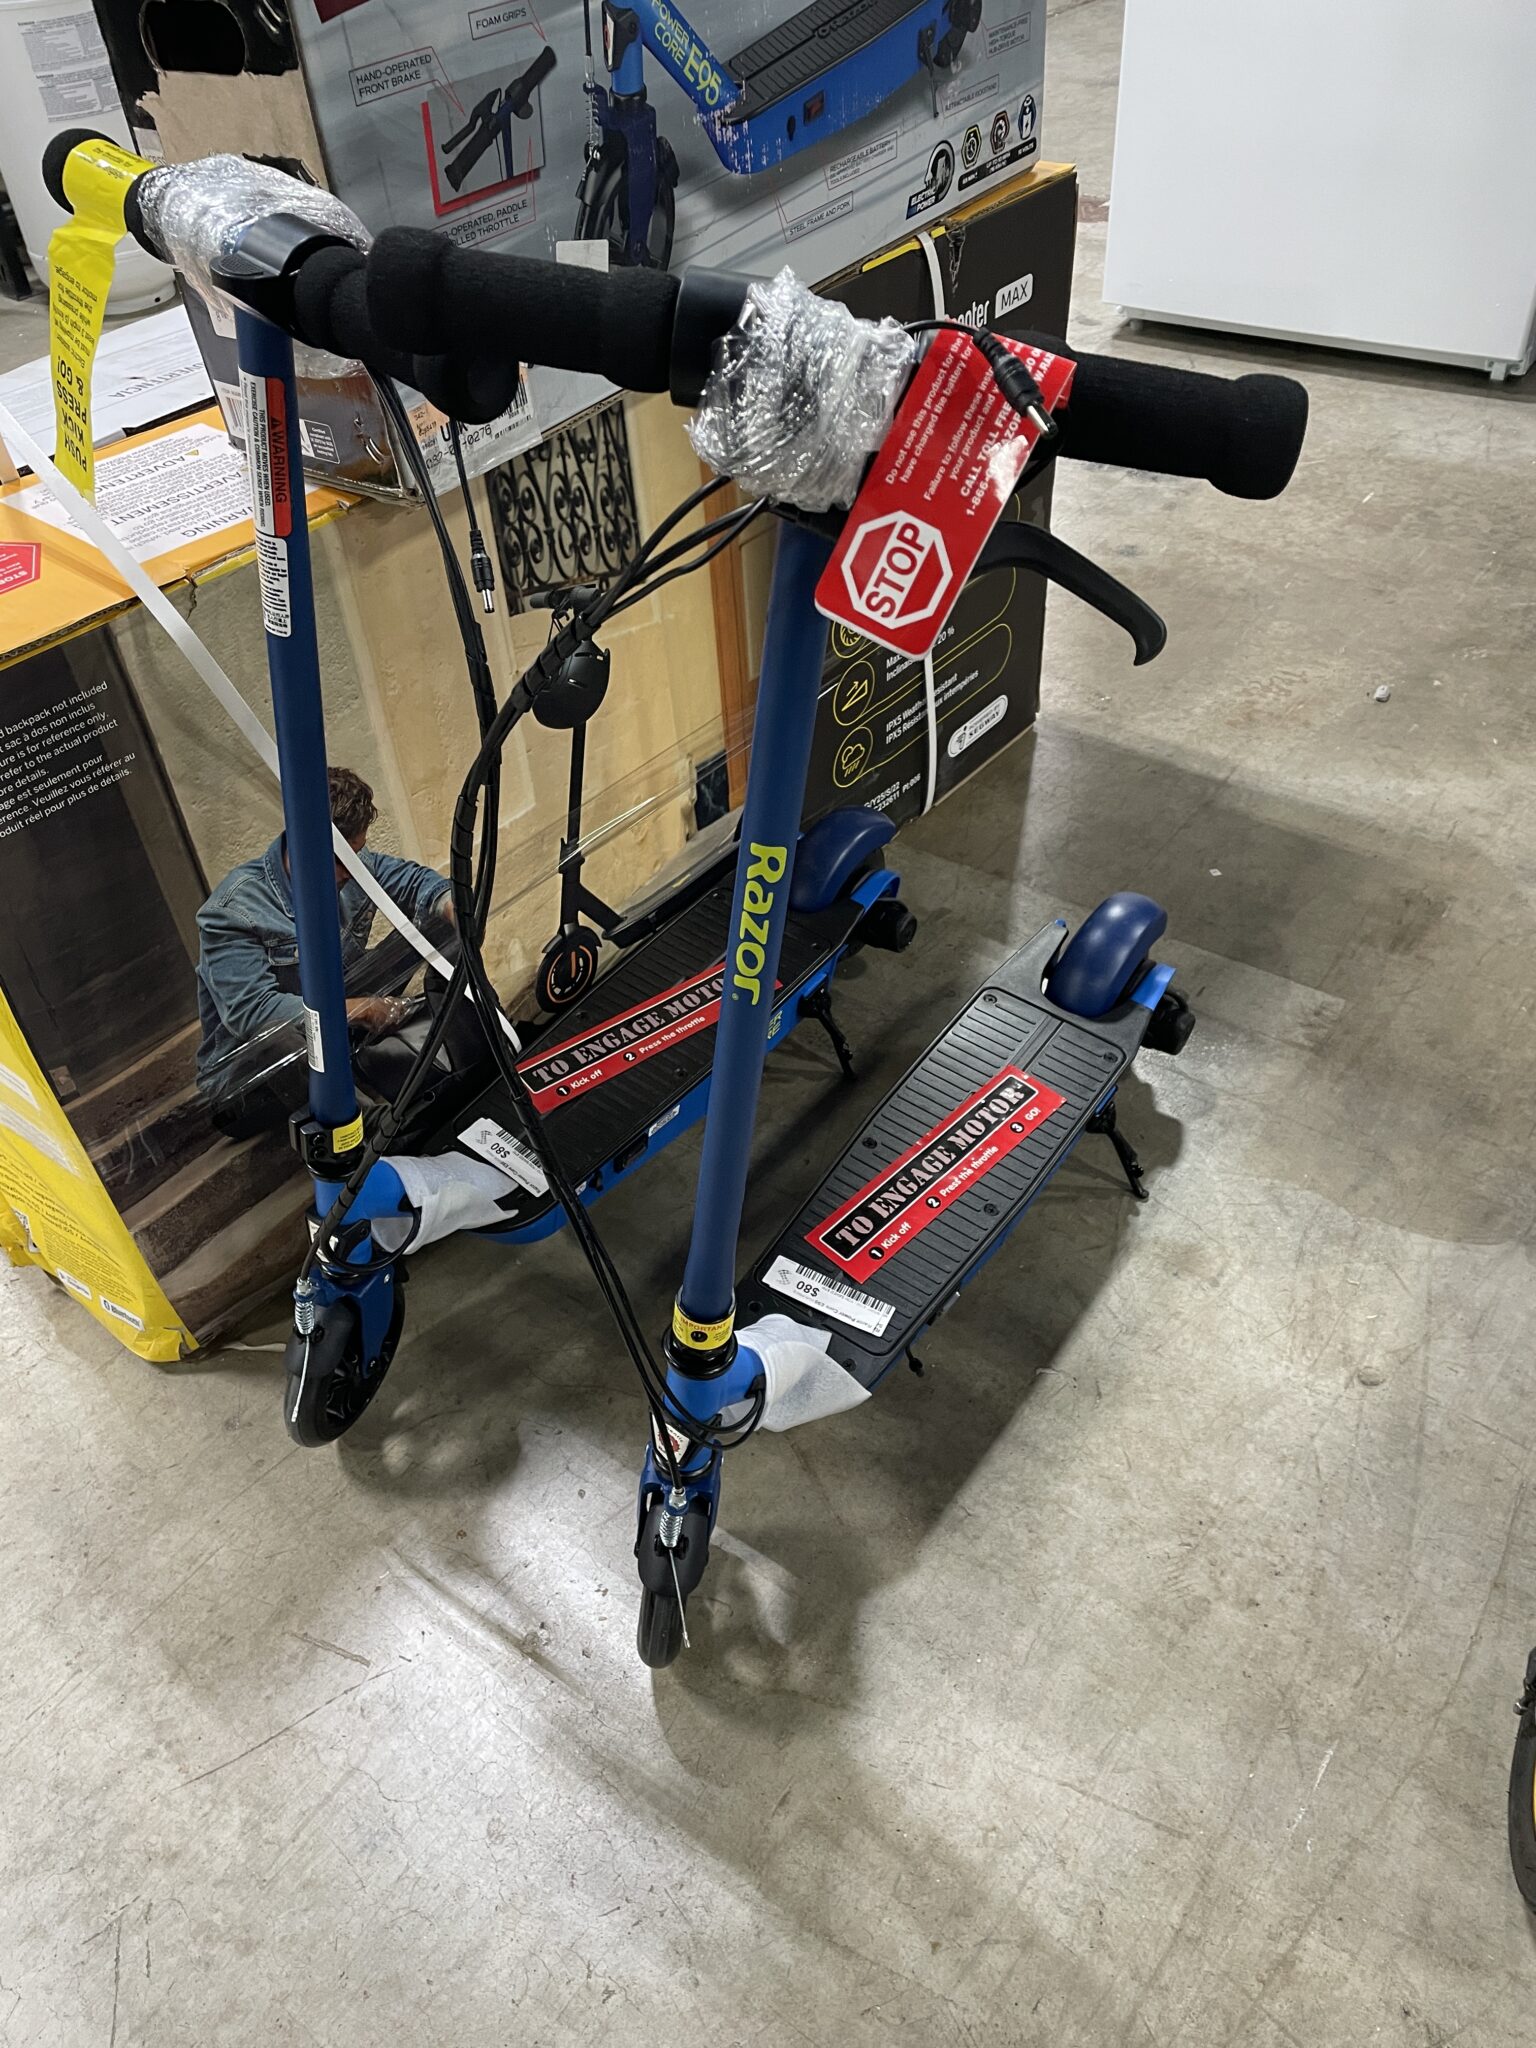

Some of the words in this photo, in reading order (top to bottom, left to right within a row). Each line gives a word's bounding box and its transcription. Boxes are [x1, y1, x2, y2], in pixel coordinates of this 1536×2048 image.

[476, 13, 502, 30] FOAM
[502, 7, 527, 22] GRIPS
[654, 22, 686, 66] CORE
[355, 54, 432, 85] HAND-OPERATED
[358, 81, 391, 98] FRONT
[391, 69, 421, 88] BRAKE
[683, 43, 722, 106] E95
[478, 214, 520, 237] THROTTLE
[496, 199, 528, 218] PADDLE
[789, 223, 806, 237] STEEL
[806, 215, 825, 228] FRAME
[825, 208, 837, 219] AND
[837, 200, 851, 213] FORK
[1000, 281, 1029, 311] MAX
[57, 355, 73, 386] GO!
[75, 375, 84, 396] &
[108, 362, 205, 398] DVERTENCIA
[56, 379, 87, 426] PRESS
[250, 381, 258, 412] EXERCISE
[254, 442, 262, 469] COMMON
[885, 467, 898, 485] Do
[896, 449, 908, 469] not
[904, 429, 917, 450] use
[912, 409, 927, 430] this
[923, 369, 948, 410] product
[941, 353, 955, 370] for
[950, 337, 963, 354] the
[900, 461, 917, 484] have
[914, 414, 939, 457] charged
[934, 396, 949, 415] the
[942, 360, 968, 399] battery
[962, 345, 974, 362] for
[61, 407, 85, 447] KICK
[260, 424, 268, 452] PRODUCT
[923, 464, 946, 501] Failure
[941, 450, 952, 466] to
[949, 422, 969, 456] follow
[965, 390, 984, 422] these
[949, 456, 966, 482] your
[962, 416, 986, 457] product
[982, 396, 996, 417] and
[959, 464, 983, 499] CALL
[977, 429, 1001, 463] TOLL
[994, 400, 1012, 430] FRE
[64, 432, 87, 473] PUSH
[94, 455, 185, 494] ADVERTENC
[270, 431, 287, 504] WARNING
[111, 472, 242, 526] AVERTISSEMENT
[865, 522, 925, 618] STOP
[4, 737, 22, 751] sac
[23, 732, 30, 743] à
[31, 724, 49, 739] dos
[49, 715, 68, 730] non
[68, 702, 96, 720] inclus
[5, 709, 52, 736] backpack
[52, 700, 69, 714] not
[69, 681, 108, 706] included
[886, 714, 902, 733] IPX5
[934, 673, 958, 697] esistant
[969, 711, 1000, 739] SEGWAY
[16, 750, 26, 760] is
[26, 742, 41, 756] for
[41, 721, 86, 748] reference
[86, 711, 109, 726] only.
[24, 759, 36, 771] to
[36, 751, 52, 765] the
[53, 737, 82, 756] actual
[82, 718, 119, 743] product
[886, 727, 902, 745] IPX5
[14, 768, 50, 788] details.
[16, 788, 33, 801] est
[33, 764, 82, 794] seulement
[82, 753, 104, 772] pour
[25, 810, 44, 826] réel
[44, 799, 67, 817] pour
[67, 788, 87, 805] plus
[87, 784, 100, 795] de
[100, 767, 133, 788] détails.
[31, 785, 69, 808] Veuillez
[69, 775, 92, 789] vous
[92, 758, 123, 779] référer
[124, 752, 136, 763] au
[733, 842, 787, 1006] Razor
[532, 1058, 570, 1084] TO
[572, 1011, 666, 1064] ENGAGE
[662, 977, 726, 1018] MOTO
[569, 1076, 590, 1090] Kick
[589, 1068, 604, 1082] off
[638, 1040, 662, 1055] Press
[661, 1030, 676, 1044] the
[674, 1015, 706, 1036] throttle
[490, 1142, 511, 1159] $80
[835, 1214, 875, 1247] TO
[867, 1145, 957, 1219] ENGAGE
[946, 1085, 1026, 1151] MOTOR
[880, 1232, 900, 1250] Kick
[898, 1221, 913, 1237] off
[938, 1177, 962, 1198] Press
[958, 1166, 975, 1181] the
[970, 1145, 999, 1170] throttle
[1024, 1107, 1042, 1121] GO!
[796, 1280, 820, 1297] $80
[680, 1317, 727, 1332] IMPORTANT
[840, 1312, 856, 1323] Power
